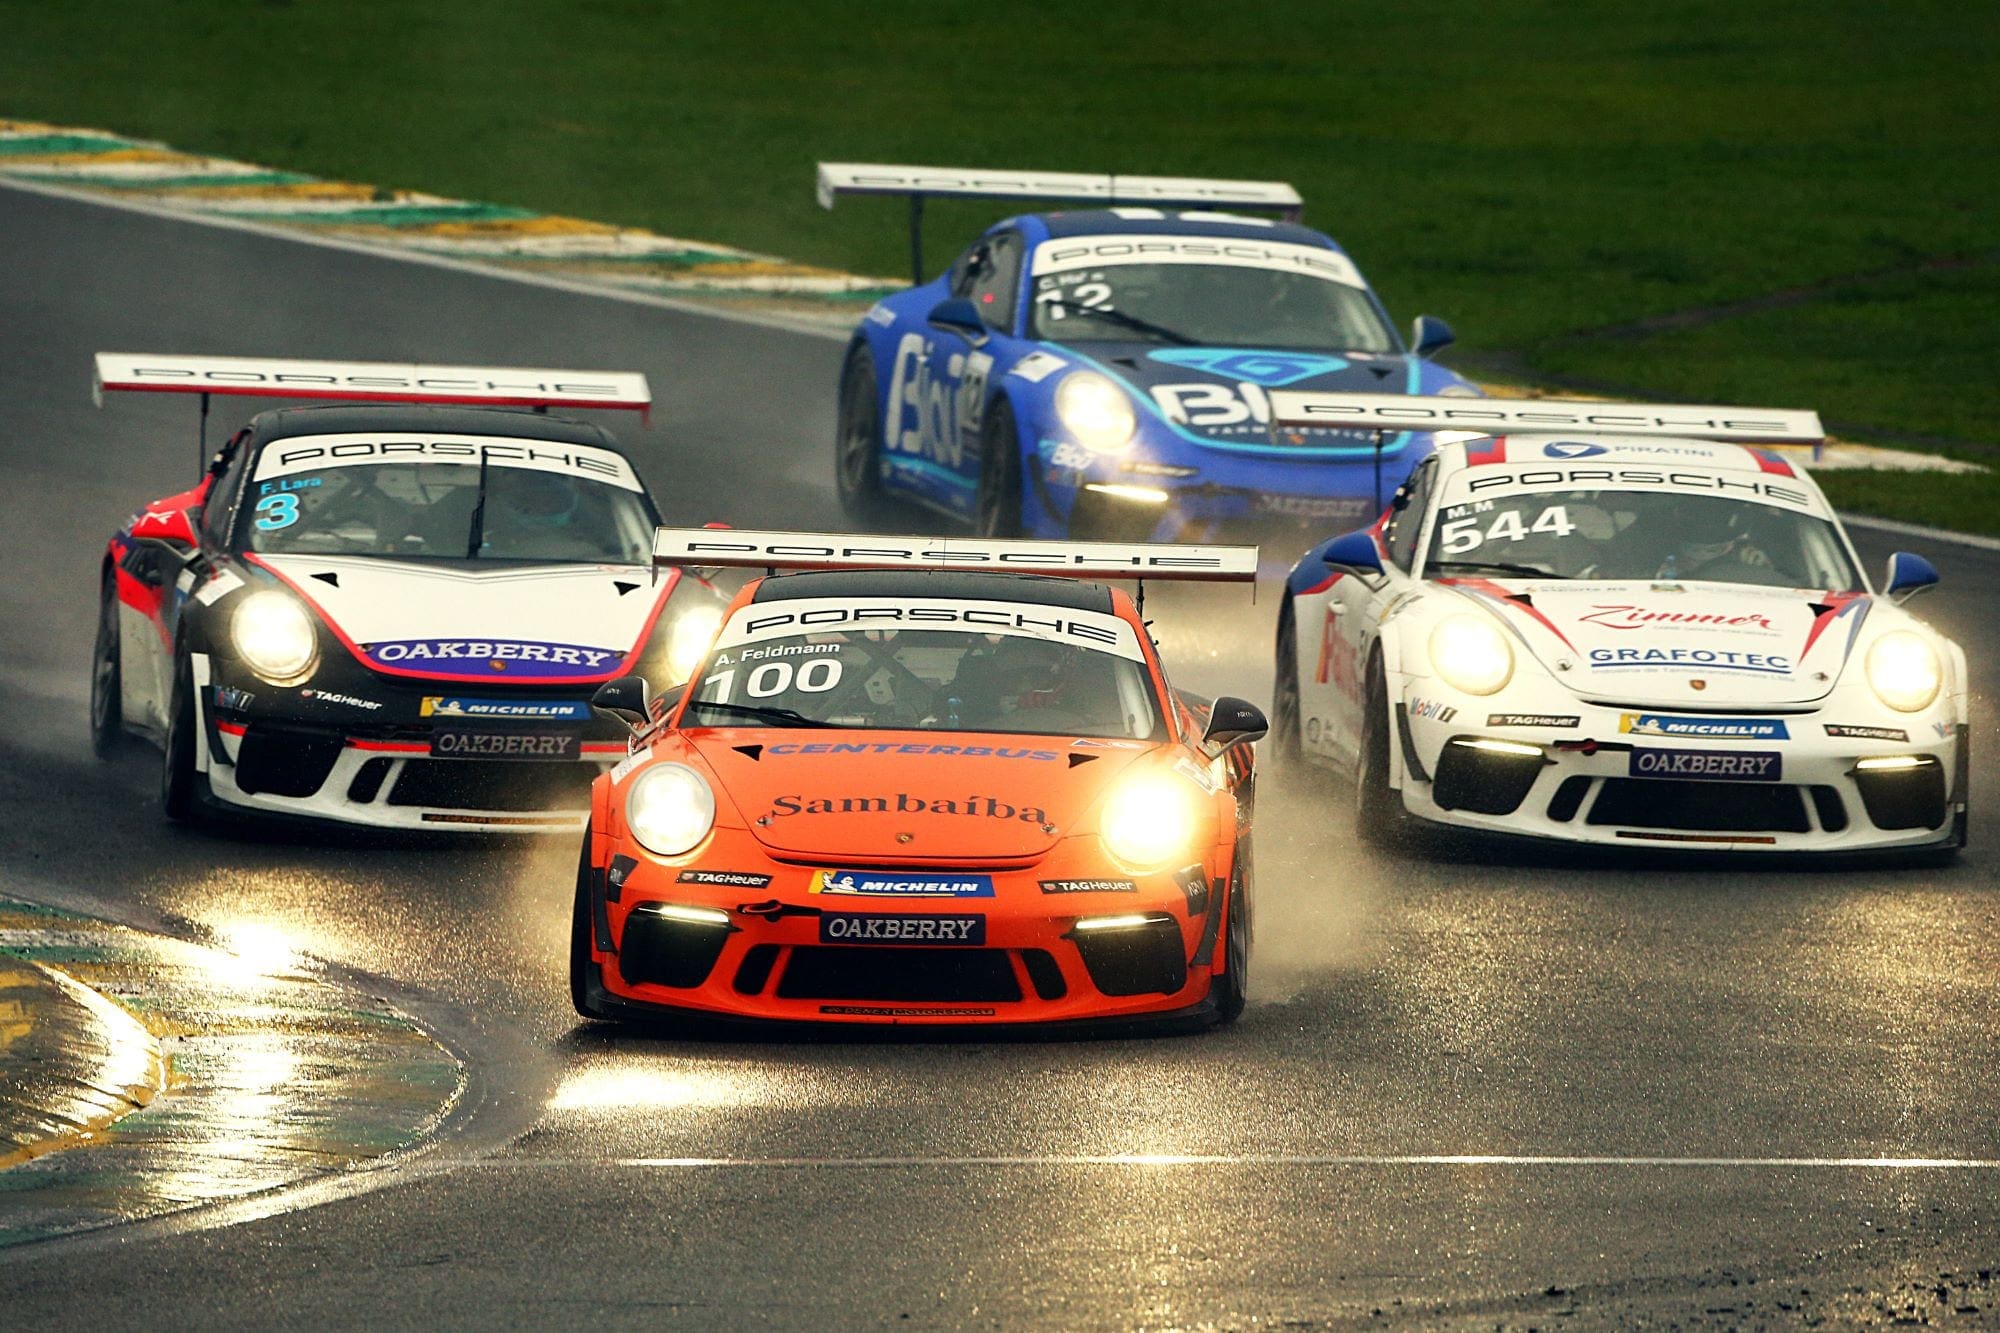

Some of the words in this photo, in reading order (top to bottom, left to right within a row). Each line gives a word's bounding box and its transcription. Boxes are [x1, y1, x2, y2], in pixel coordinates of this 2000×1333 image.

[1051, 243, 1343, 274] PORSCHE
[132, 366, 618, 396] PORSCHE
[1302, 403, 1790, 433] PORSCHE
[279, 442, 621, 478] PORSCHE
[280, 477, 323, 491] Lara
[1468, 470, 1809, 506] PORSCHE
[254, 493, 300, 531] 3
[1441, 505, 1577, 555] 544
[686, 542, 1222, 568] PORSCHE
[746, 606, 1118, 646] PORSCHE
[1578, 605, 1772, 632] Zimmer
[378, 642, 609, 668] OAKBERRY
[714, 654, 735, 667] A.
[740, 643, 841, 662] Feldmann
[1589, 648, 1791, 669] GRAFOTEC
[704, 658, 843, 705] 100
[467, 703, 576, 716] MICHELIN
[1410, 696, 1442, 719] Mobil
[1666, 723, 1774, 736] MICHELIN
[438, 733, 573, 755] OAKBERRY
[768, 742, 1060, 763] CENTERBUS
[1638, 754, 1773, 776] OAKBERRY
[770, 794, 1047, 826] Sambaíba
[861, 880, 979, 893] MICHELIN
[828, 917, 976, 940] OAKBERRY
